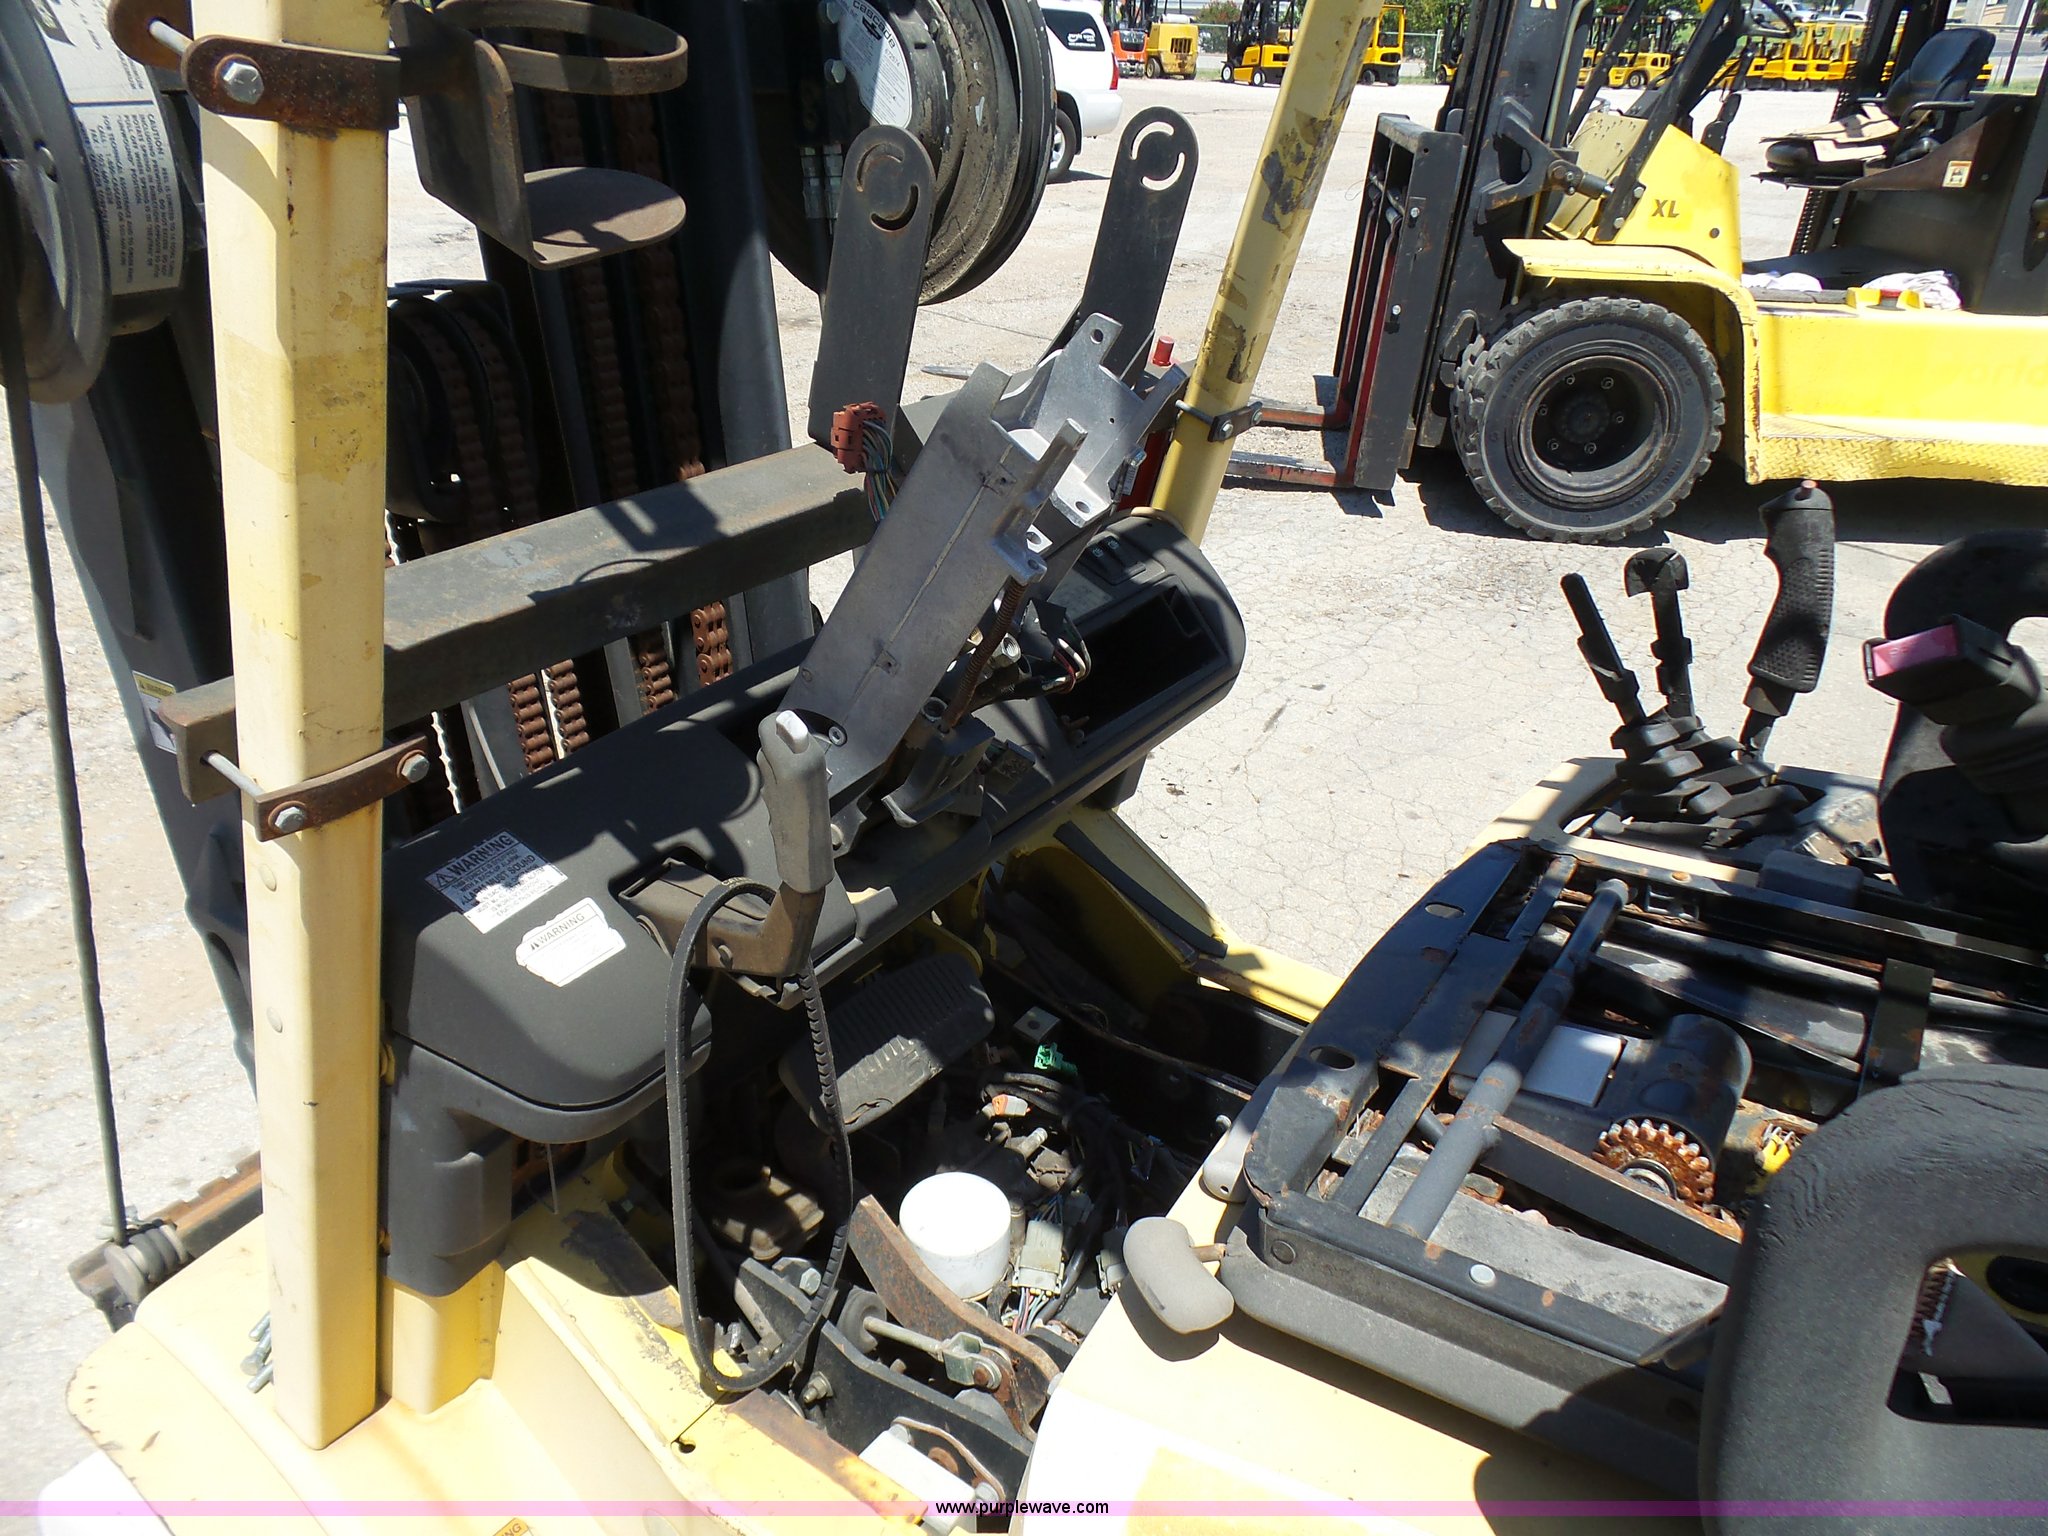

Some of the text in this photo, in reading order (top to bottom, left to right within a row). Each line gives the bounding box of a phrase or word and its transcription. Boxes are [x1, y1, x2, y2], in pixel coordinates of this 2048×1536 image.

[853, 0, 895, 48] cascade
[103, 115, 112, 130] FOR
[123, 114, 134, 132] PULL
[130, 135, 139, 149] OFF
[132, 115, 144, 141] ROTATE
[139, 114, 156, 157] INCLUDING
[1652, 199, 1680, 218] XL
[446, 832, 515, 877] WARNING
[506, 854, 537, 874] SOUND
[540, 913, 585, 944] WARNING
